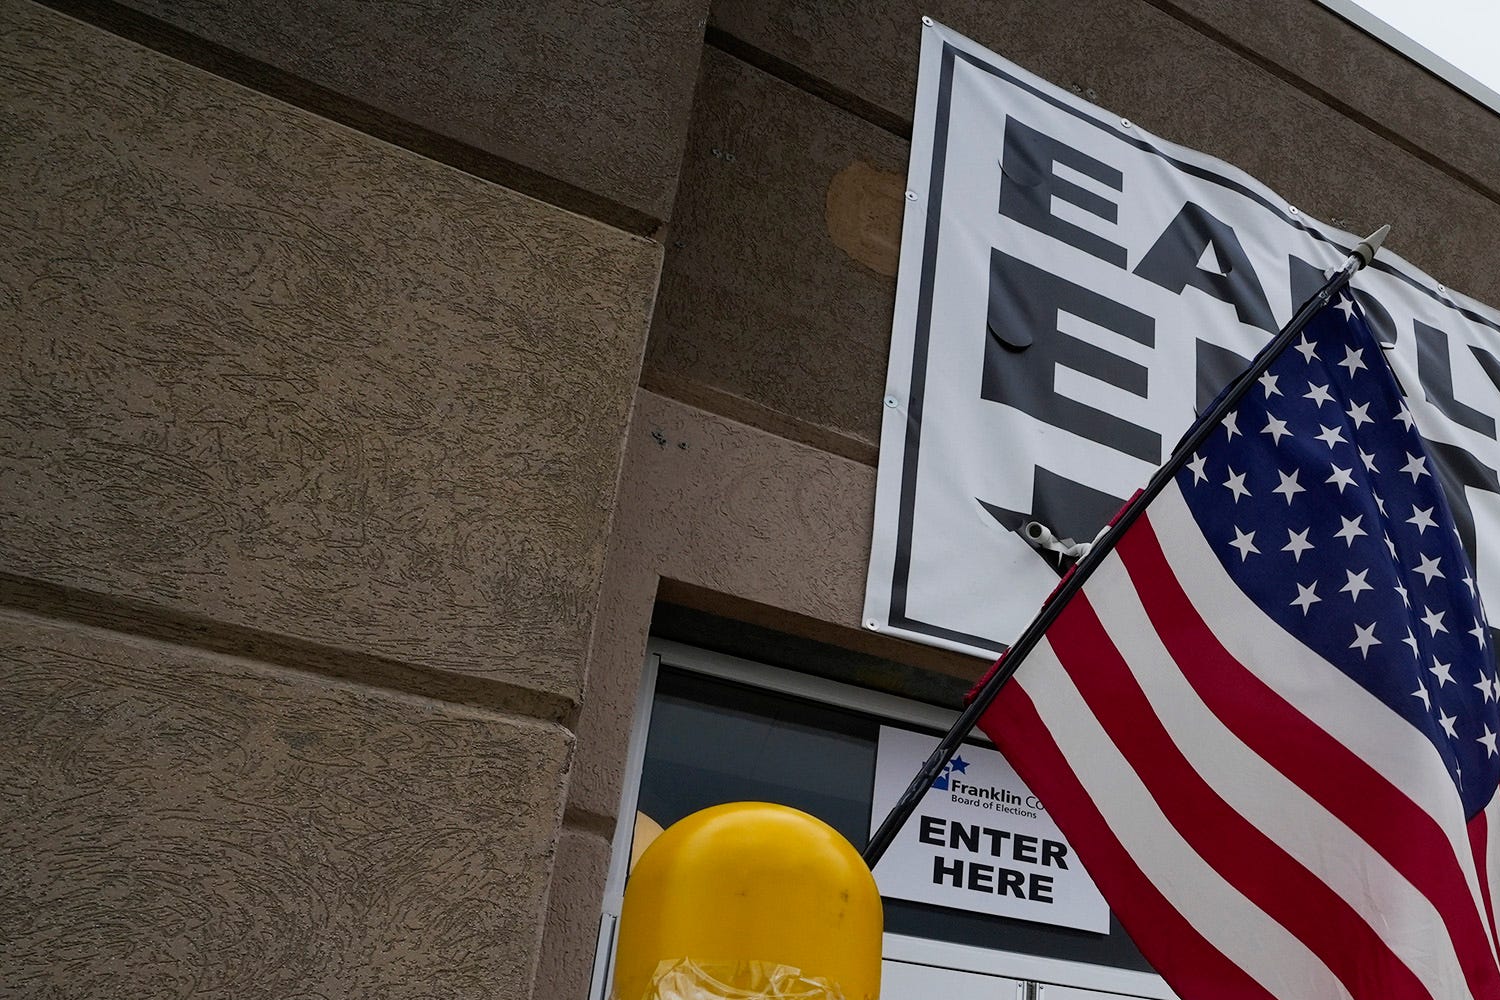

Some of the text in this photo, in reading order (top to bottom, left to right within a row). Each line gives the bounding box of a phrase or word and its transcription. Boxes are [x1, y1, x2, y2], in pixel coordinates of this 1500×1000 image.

[951, 794, 980, 808] Board
[982, 800, 994, 810] of
[996, 803, 1037, 819] Elections
[952, 780, 1022, 806] Franklin
[919, 815, 1069, 870] ENTER
[932, 855, 1054, 904] HERE
